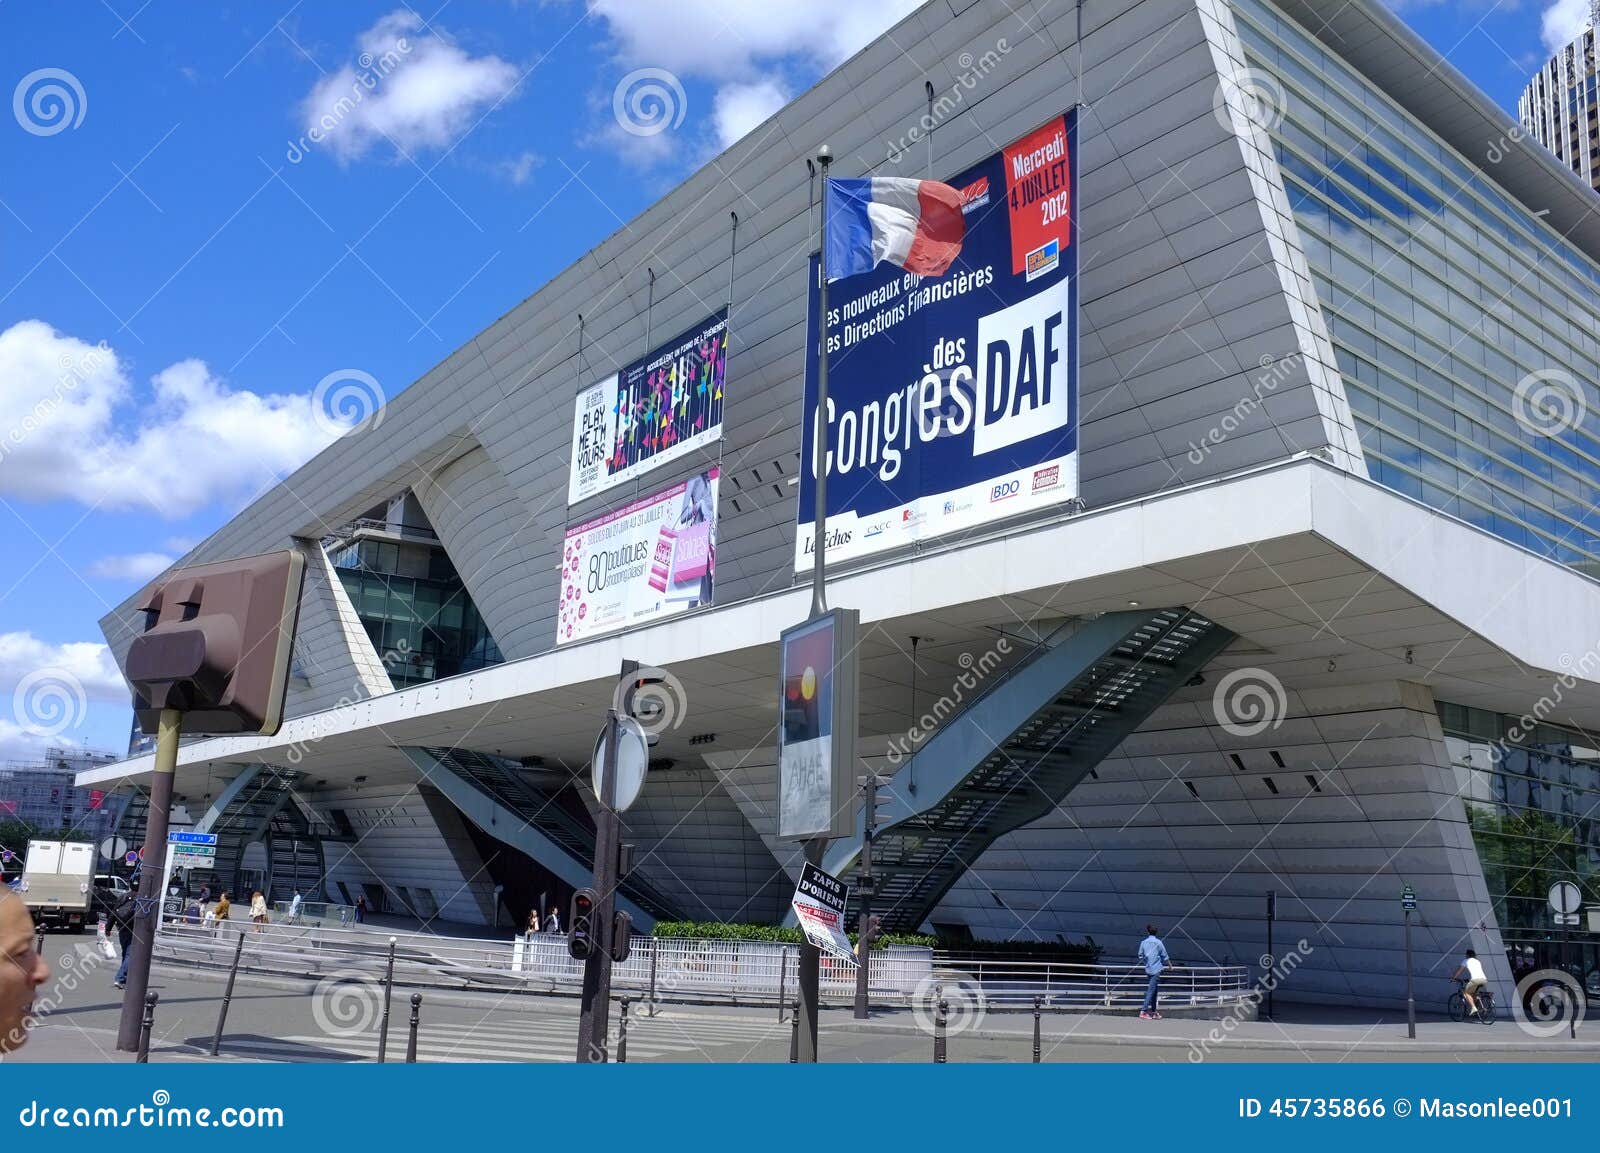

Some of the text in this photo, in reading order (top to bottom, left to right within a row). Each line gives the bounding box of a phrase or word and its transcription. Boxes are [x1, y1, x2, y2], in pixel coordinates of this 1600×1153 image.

[1012, 131, 1065, 180] Mercredi
[1011, 187, 1019, 211] 4
[1022, 160, 1066, 206] JUILLET
[1041, 190, 1068, 226] 2012
[843, 278, 900, 321] nouveaux
[844, 303, 905, 347] Directions
[908, 265, 993, 316] Financières
[933, 337, 966, 369] des
[812, 310, 1063, 481] Congrès DAF
[582, 404, 606, 433] PLAY
[577, 443, 606, 471] YOURS
[579, 430, 591, 453] ME
[993, 479, 1020, 499] BDO
[867, 520, 892, 534] CNCC
[588, 552, 609, 593] 80
[608, 540, 648, 571] boutiques
[800, 880, 844, 909] D'ORIENT
[813, 870, 841, 893] TAPIS
